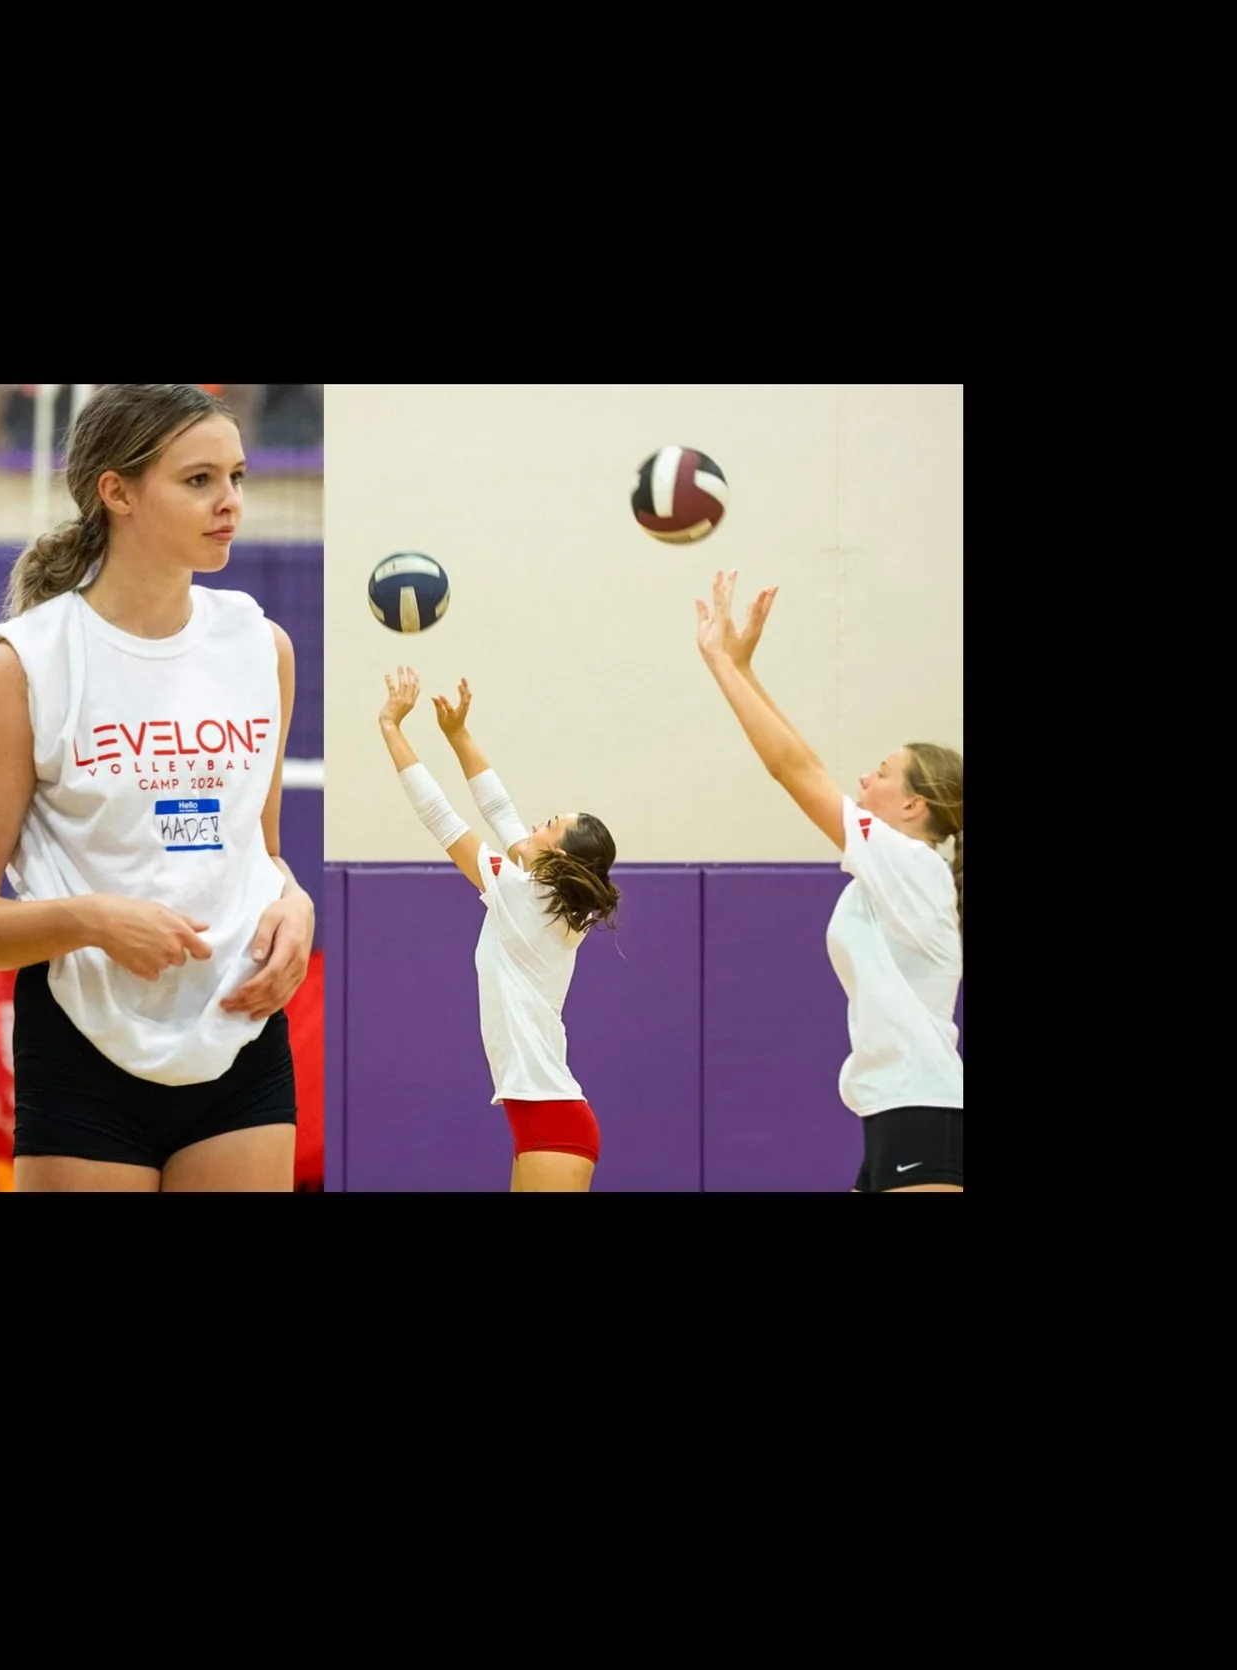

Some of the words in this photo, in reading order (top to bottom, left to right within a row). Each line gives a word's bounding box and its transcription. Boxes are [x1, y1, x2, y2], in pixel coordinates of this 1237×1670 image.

[139, 778, 179, 790] CAMP
[190, 777, 224, 790] 2024
[178, 801, 198, 809] Hello
[161, 815, 220, 842] KADE!
